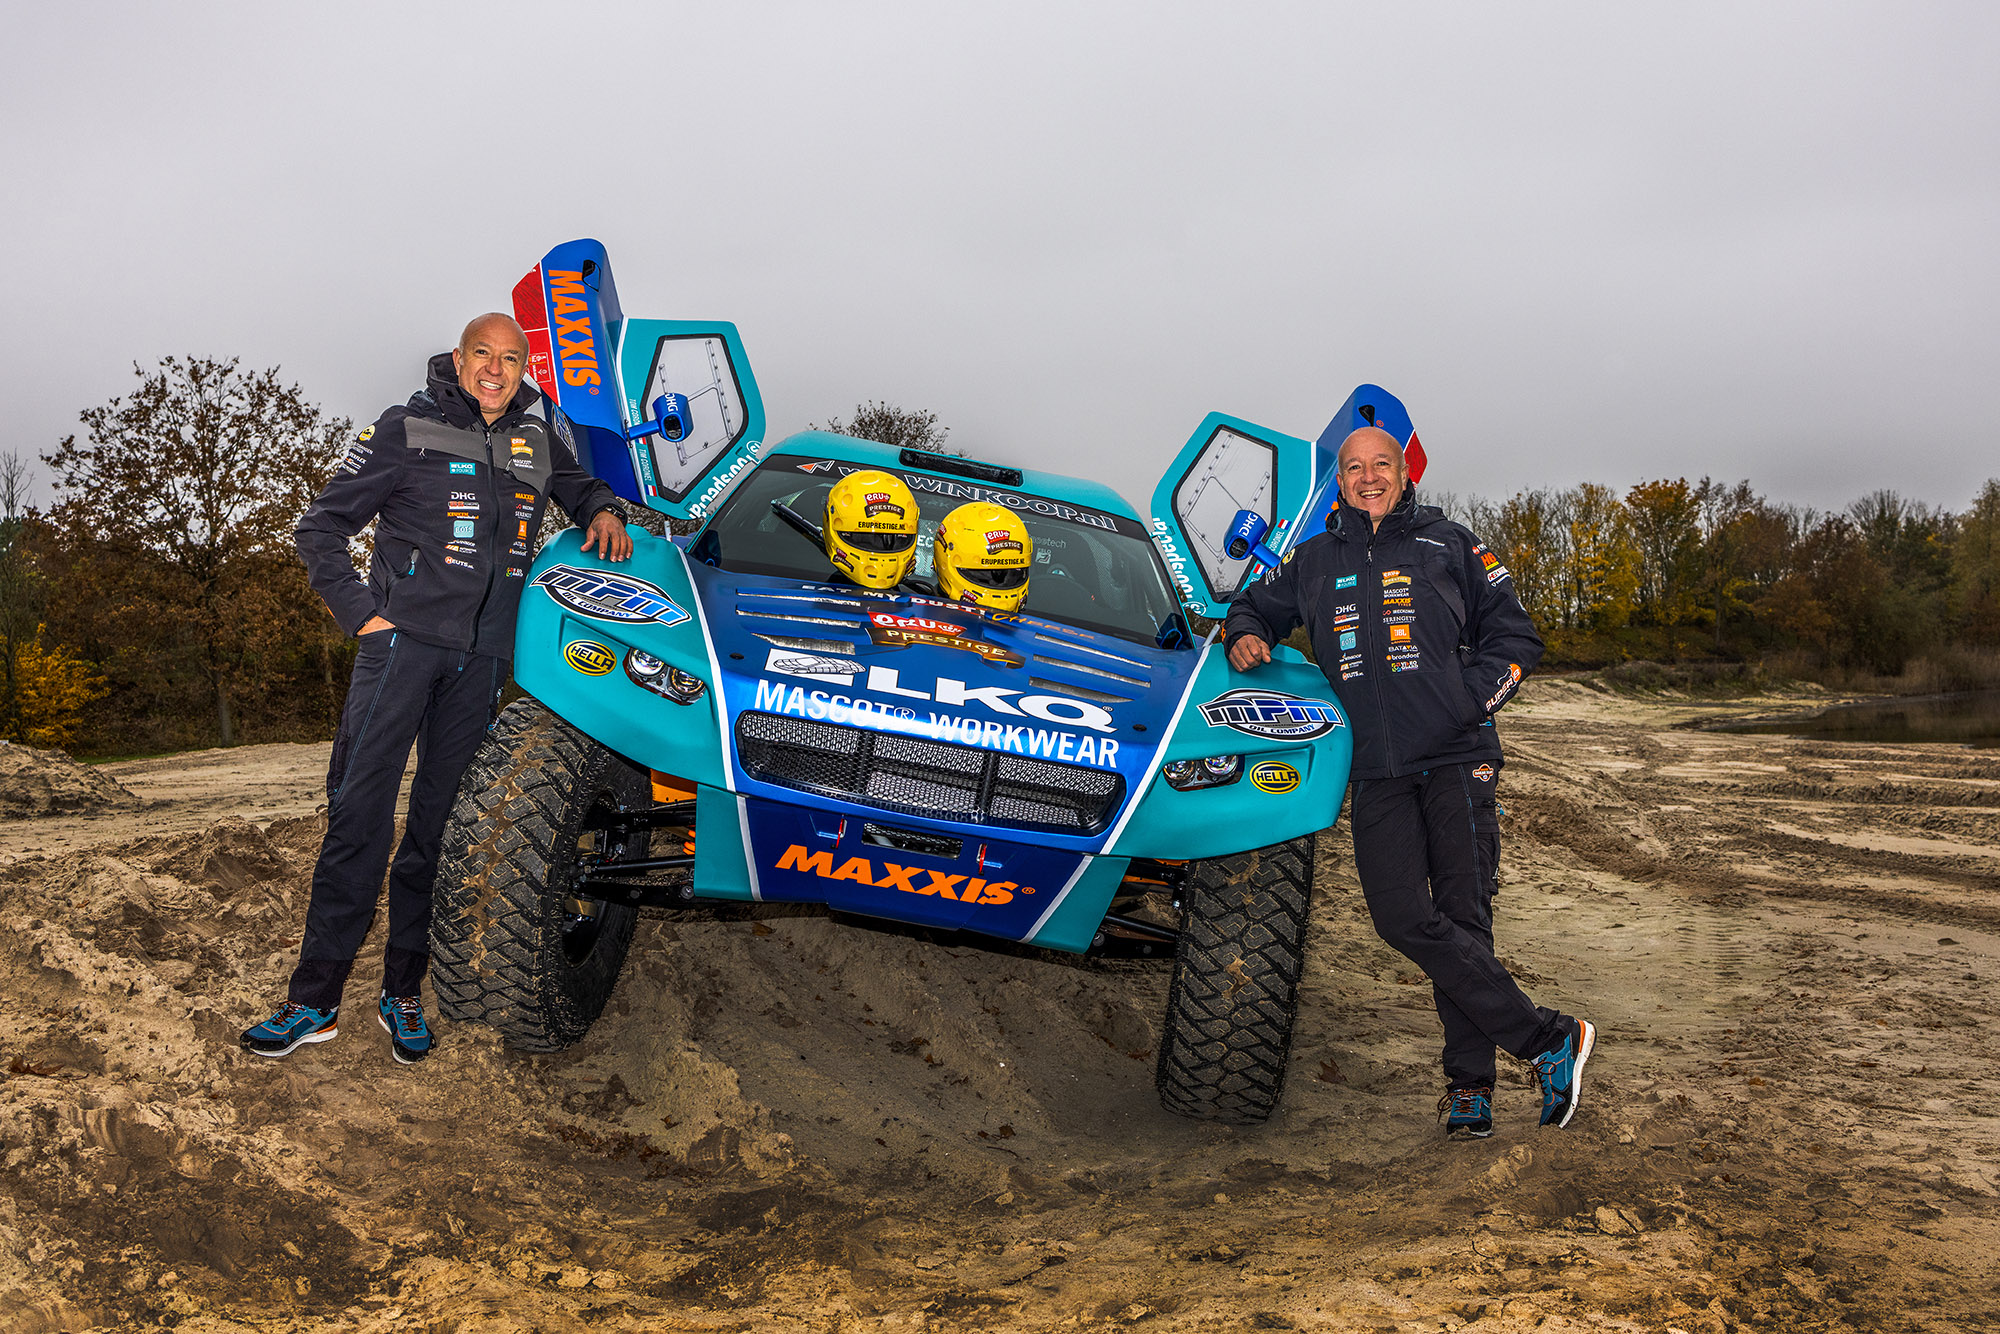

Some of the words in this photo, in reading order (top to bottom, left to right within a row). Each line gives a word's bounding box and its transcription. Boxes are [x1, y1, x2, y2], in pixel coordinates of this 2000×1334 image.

[450, 491, 476, 500] DHG
[1238, 513, 1259, 537] DHG
[801, 584, 853, 593] EAT
[863, 591, 902, 602] MY
[577, 600, 633, 618] COMPANY
[1335, 603, 1357, 615] DHG
[885, 629, 1007, 657] PRESTIGE
[570, 645, 615, 673] HELLA
[1270, 723, 1315, 734] COMPANY
[928, 712, 1120, 769] WORKWEAR
[1255, 771, 1299, 783] HELLA
